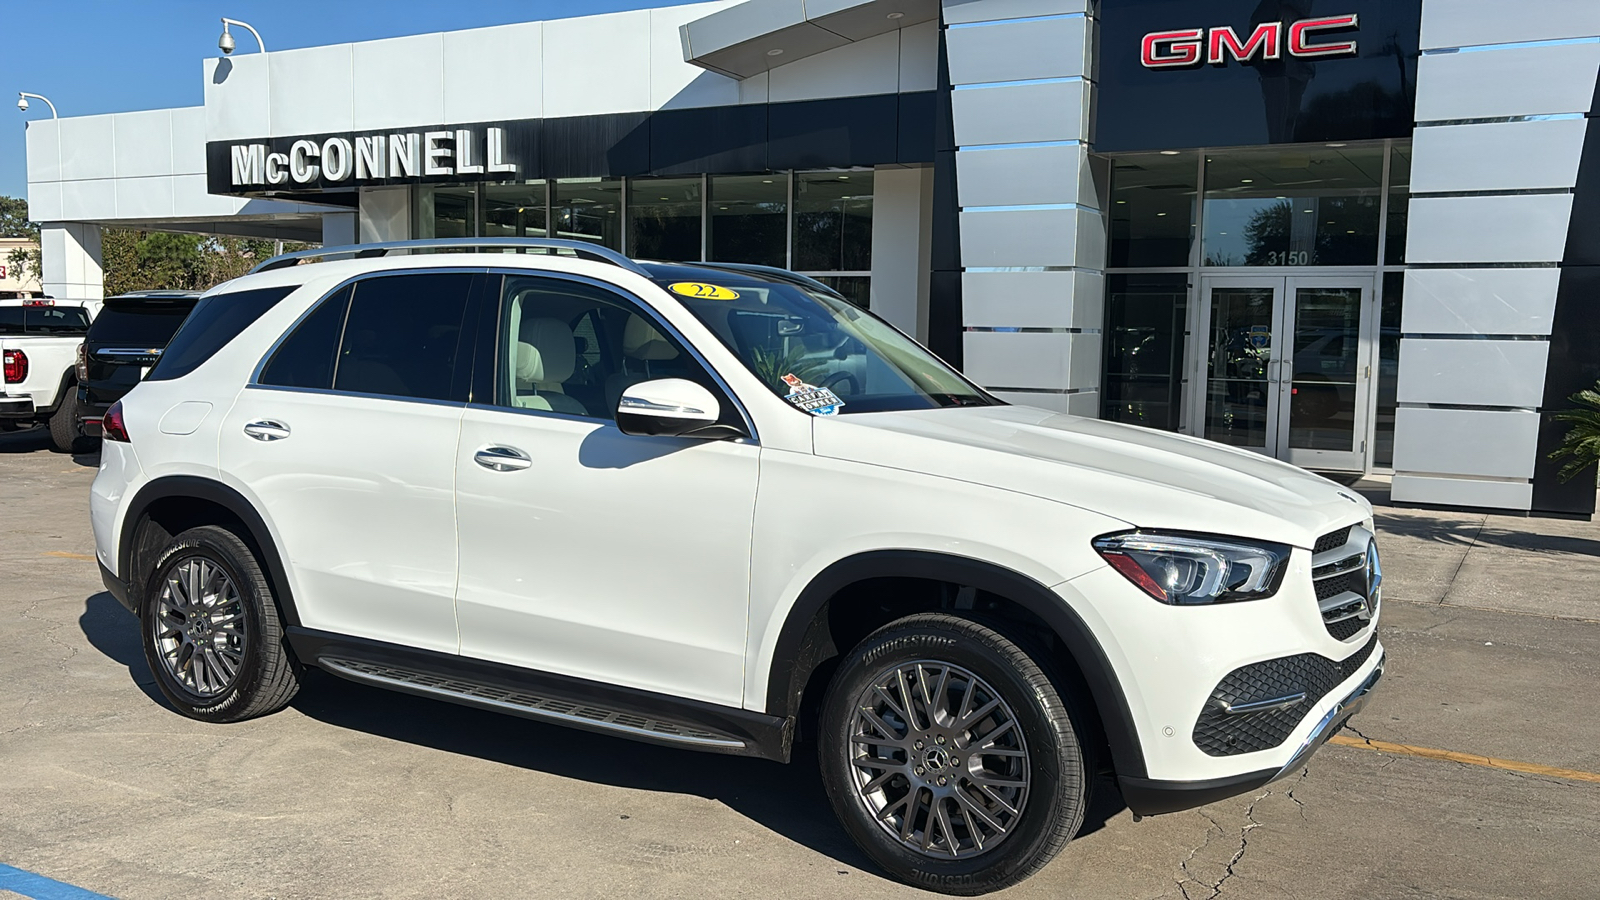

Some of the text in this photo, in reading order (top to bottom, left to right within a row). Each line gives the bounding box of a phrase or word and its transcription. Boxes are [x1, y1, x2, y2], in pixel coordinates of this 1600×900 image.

[1141, 13, 1358, 67] GMC
[231, 127, 517, 186] McCONNELL
[1267, 250, 1308, 266] 3150
[691, 284, 719, 298] 22
[862, 634, 957, 667] BRIDGESTONE
